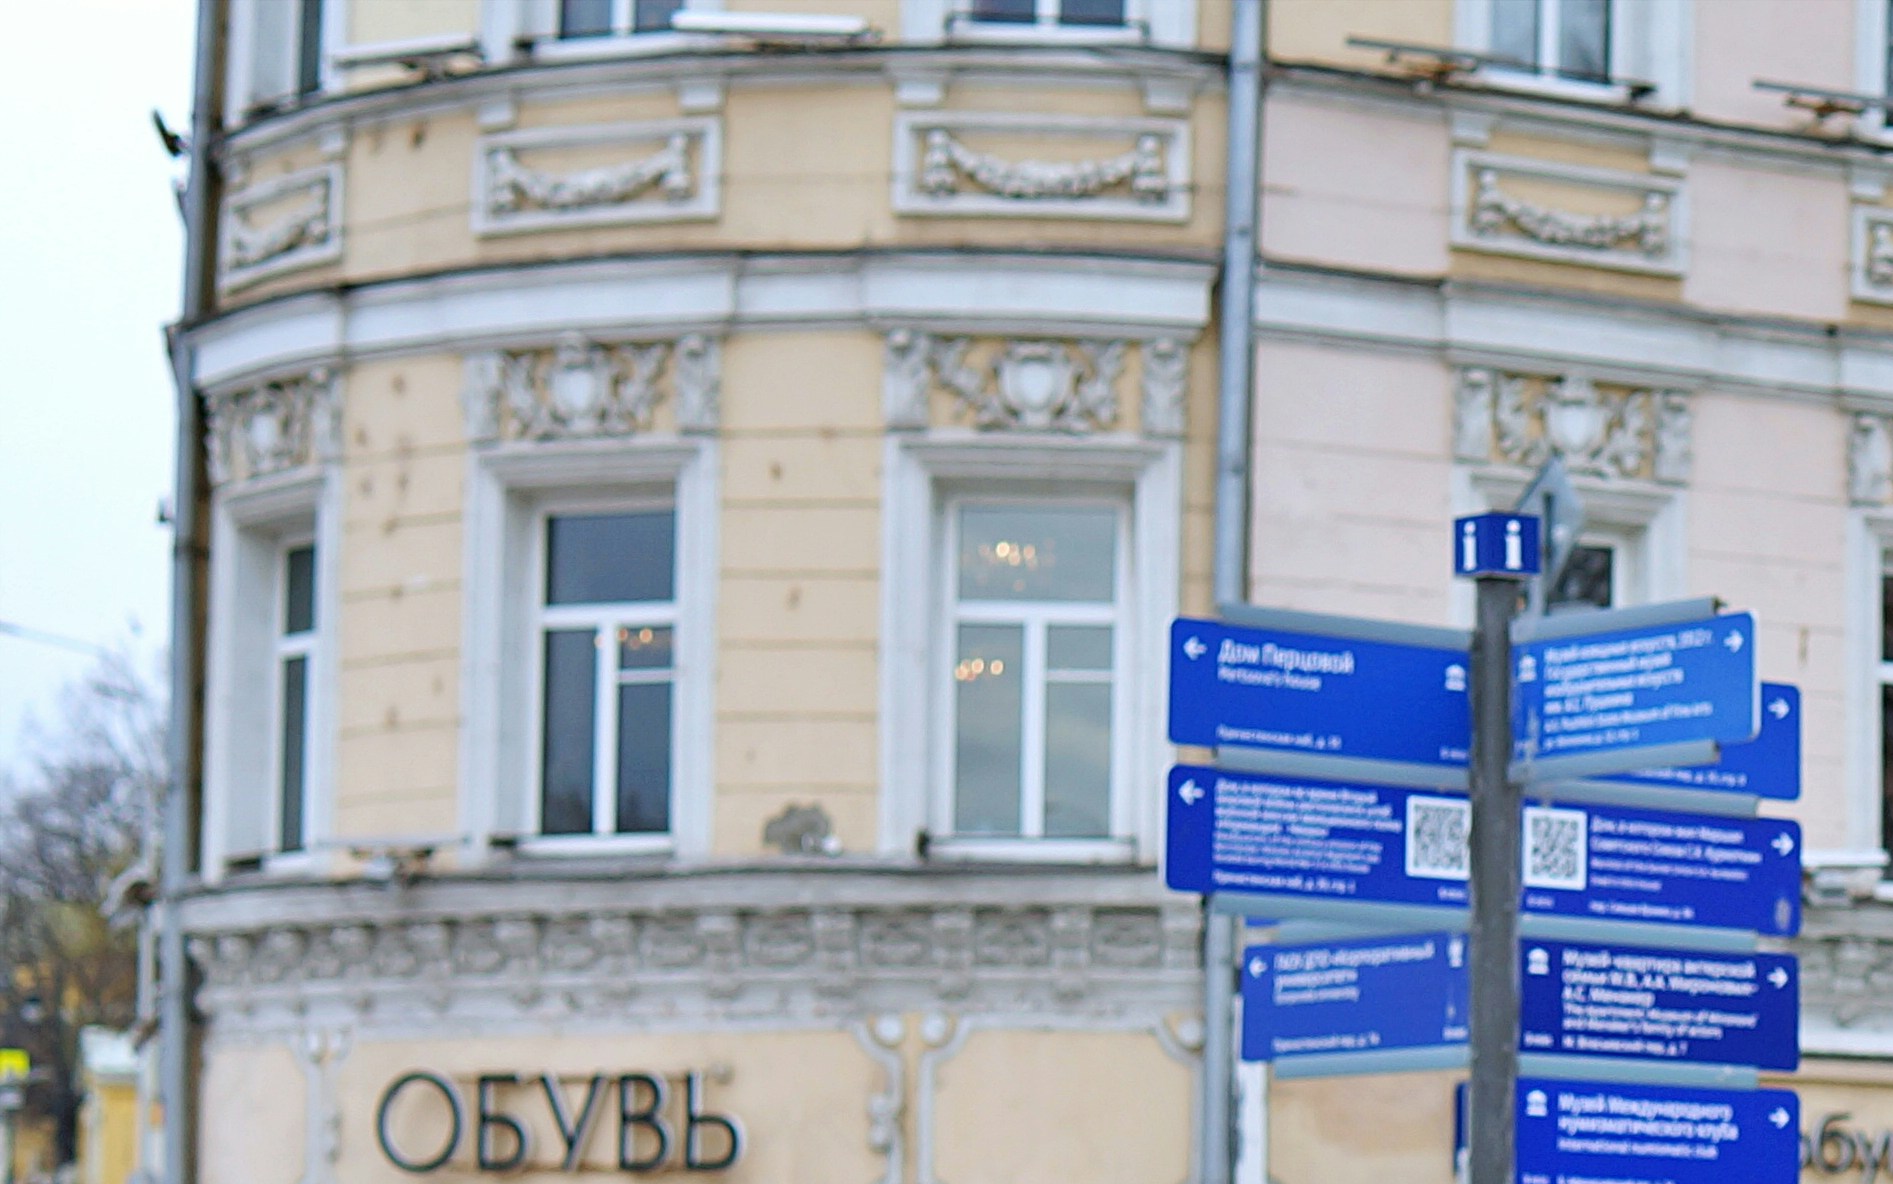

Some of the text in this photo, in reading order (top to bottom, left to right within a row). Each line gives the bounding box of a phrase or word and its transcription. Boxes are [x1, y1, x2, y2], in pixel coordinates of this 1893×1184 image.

[1217, 638, 1354, 675] Дом Перцовой
[1561, 969, 1608, 988] семьи
[1562, 1016, 1586, 1032] and
[1642, 1021, 1674, 1037] family
[1558, 1092, 1733, 1123] Музей Международного
[375, 1070, 743, 1174] ОБУВЬ
[1558, 1114, 1739, 1142] нумизматического клуба
[1557, 1136, 1627, 1154] International
[1694, 1143, 1718, 1159] club
